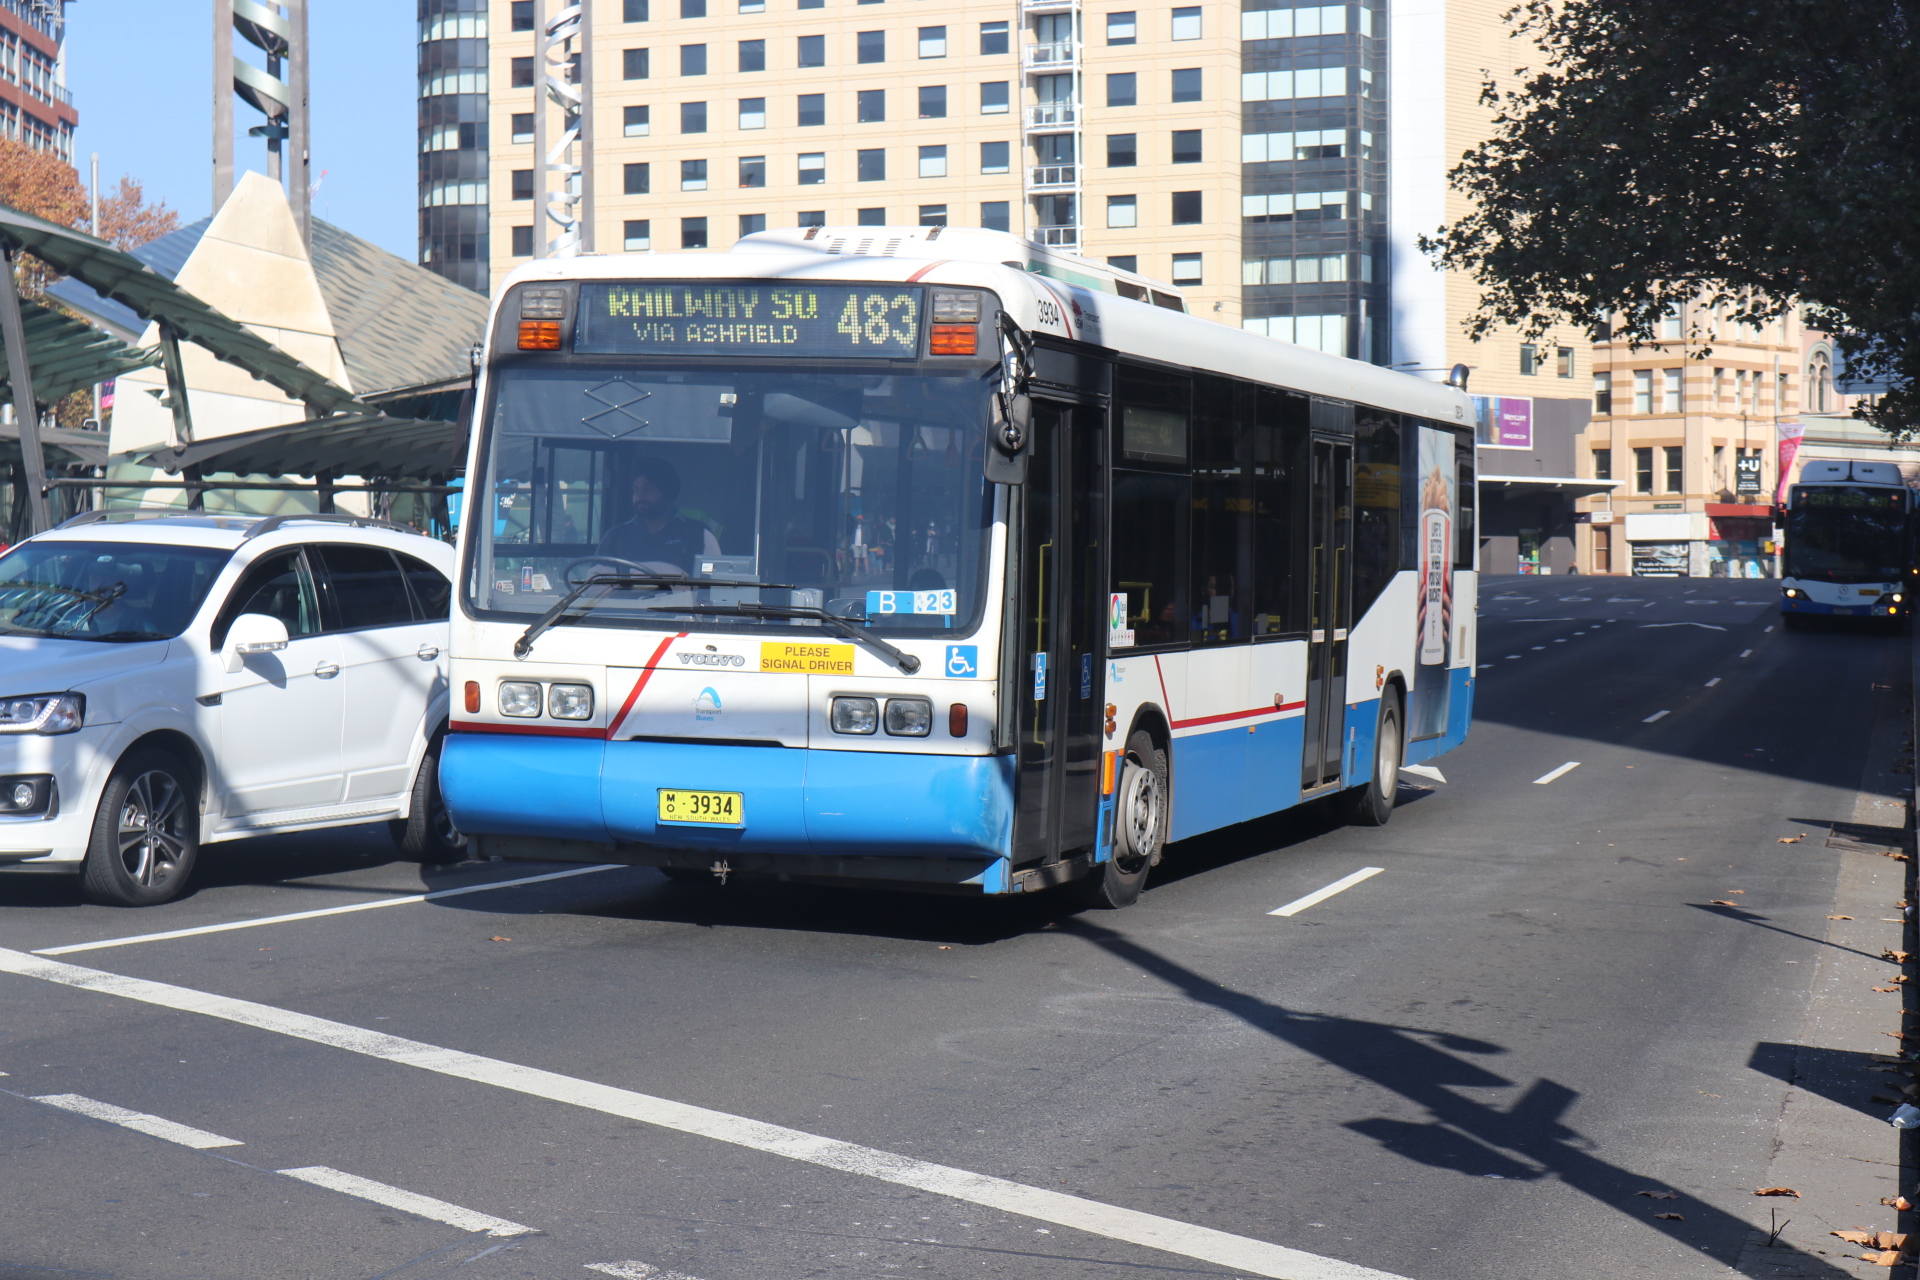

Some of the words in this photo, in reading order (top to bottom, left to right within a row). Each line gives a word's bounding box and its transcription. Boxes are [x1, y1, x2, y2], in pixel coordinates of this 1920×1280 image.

[608, 288, 758, 318] RAILWAY
[1037, 299, 1059, 326] 3934
[837, 294, 917, 344] 483
[633, 322, 675, 342] VIA
[686, 323, 798, 344] ASHFIELD
[1810, 493, 1835, 505] CITY
[880, 591, 897, 613] B
[677, 652, 745, 667] VOLVO
[785, 646, 830, 658] PLEASE
[762, 659, 805, 670] SIGNAL
[809, 660, 853, 672] DRIVER
[695, 707, 722, 715] Transport
[690, 794, 732, 816] 3934
